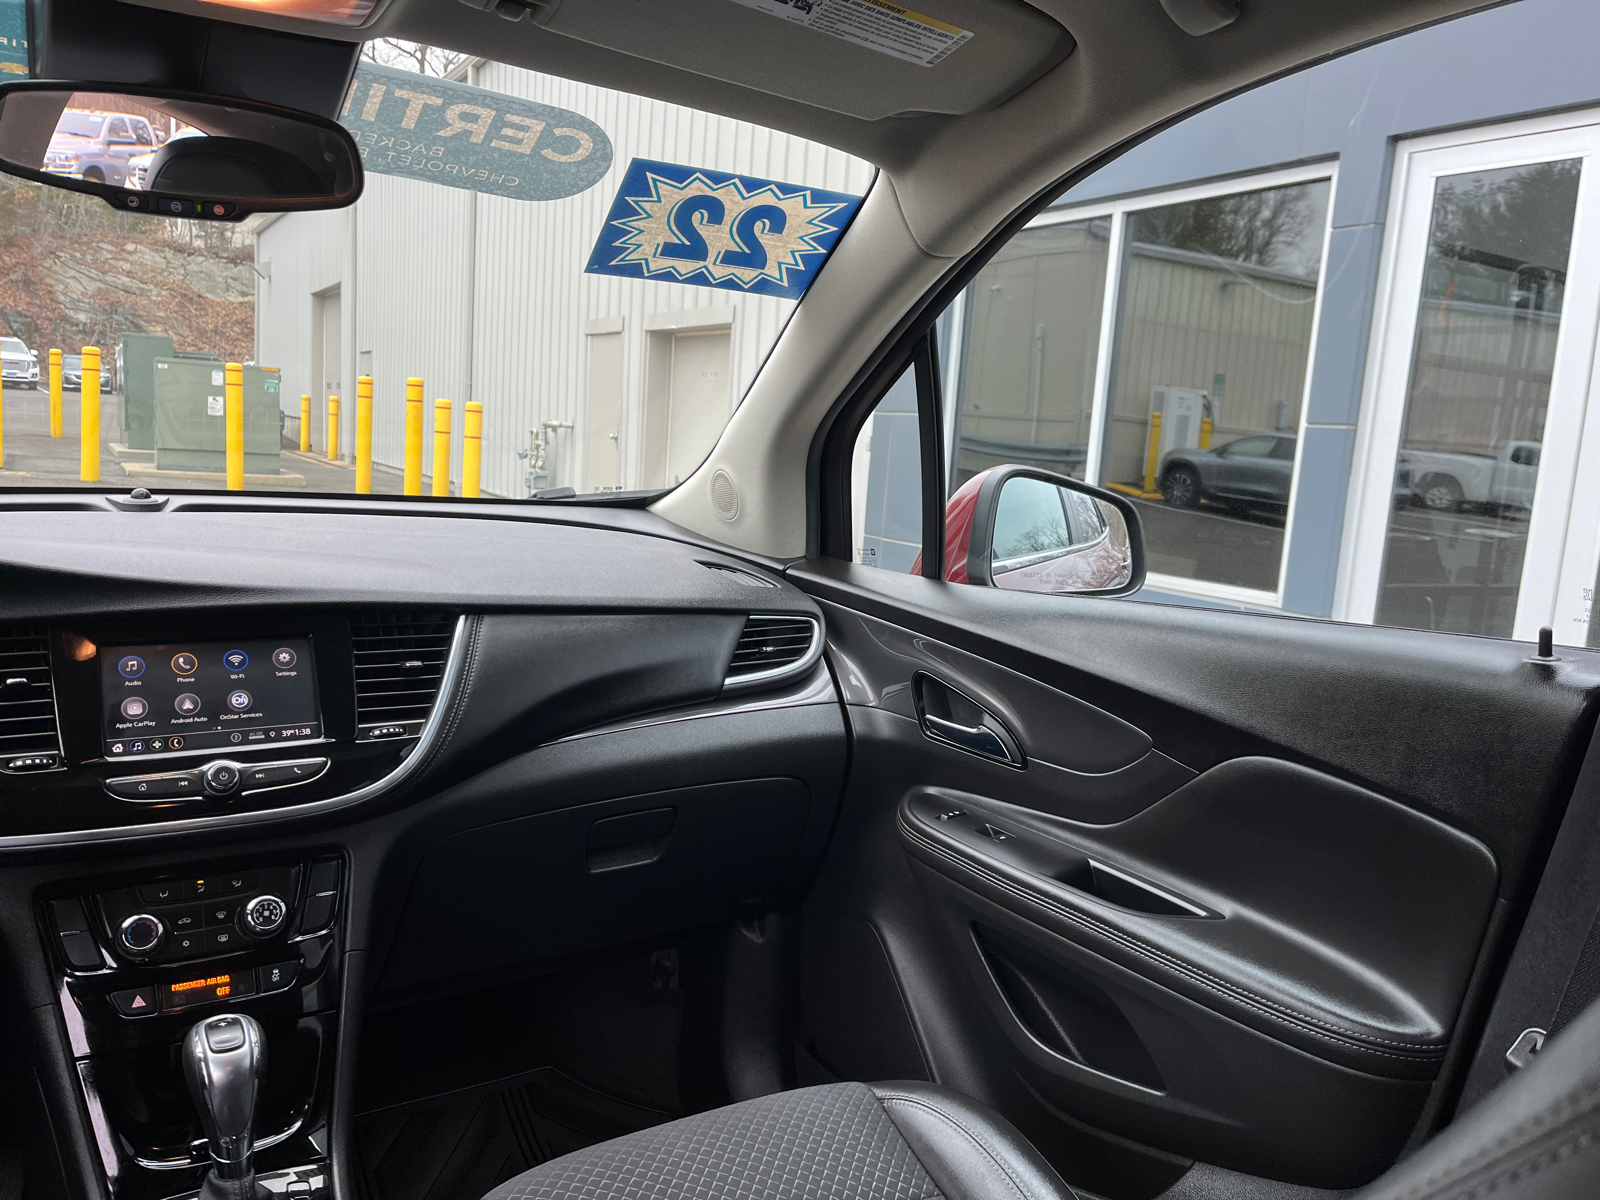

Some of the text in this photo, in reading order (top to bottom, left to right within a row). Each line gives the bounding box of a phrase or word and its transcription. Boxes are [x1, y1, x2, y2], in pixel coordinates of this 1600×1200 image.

[133, 720, 156, 728] CarPlay
[294, 728, 312, 736] 1:38
[171, 979, 206, 992] PASSENGER
[216, 986, 231, 996] OFF
